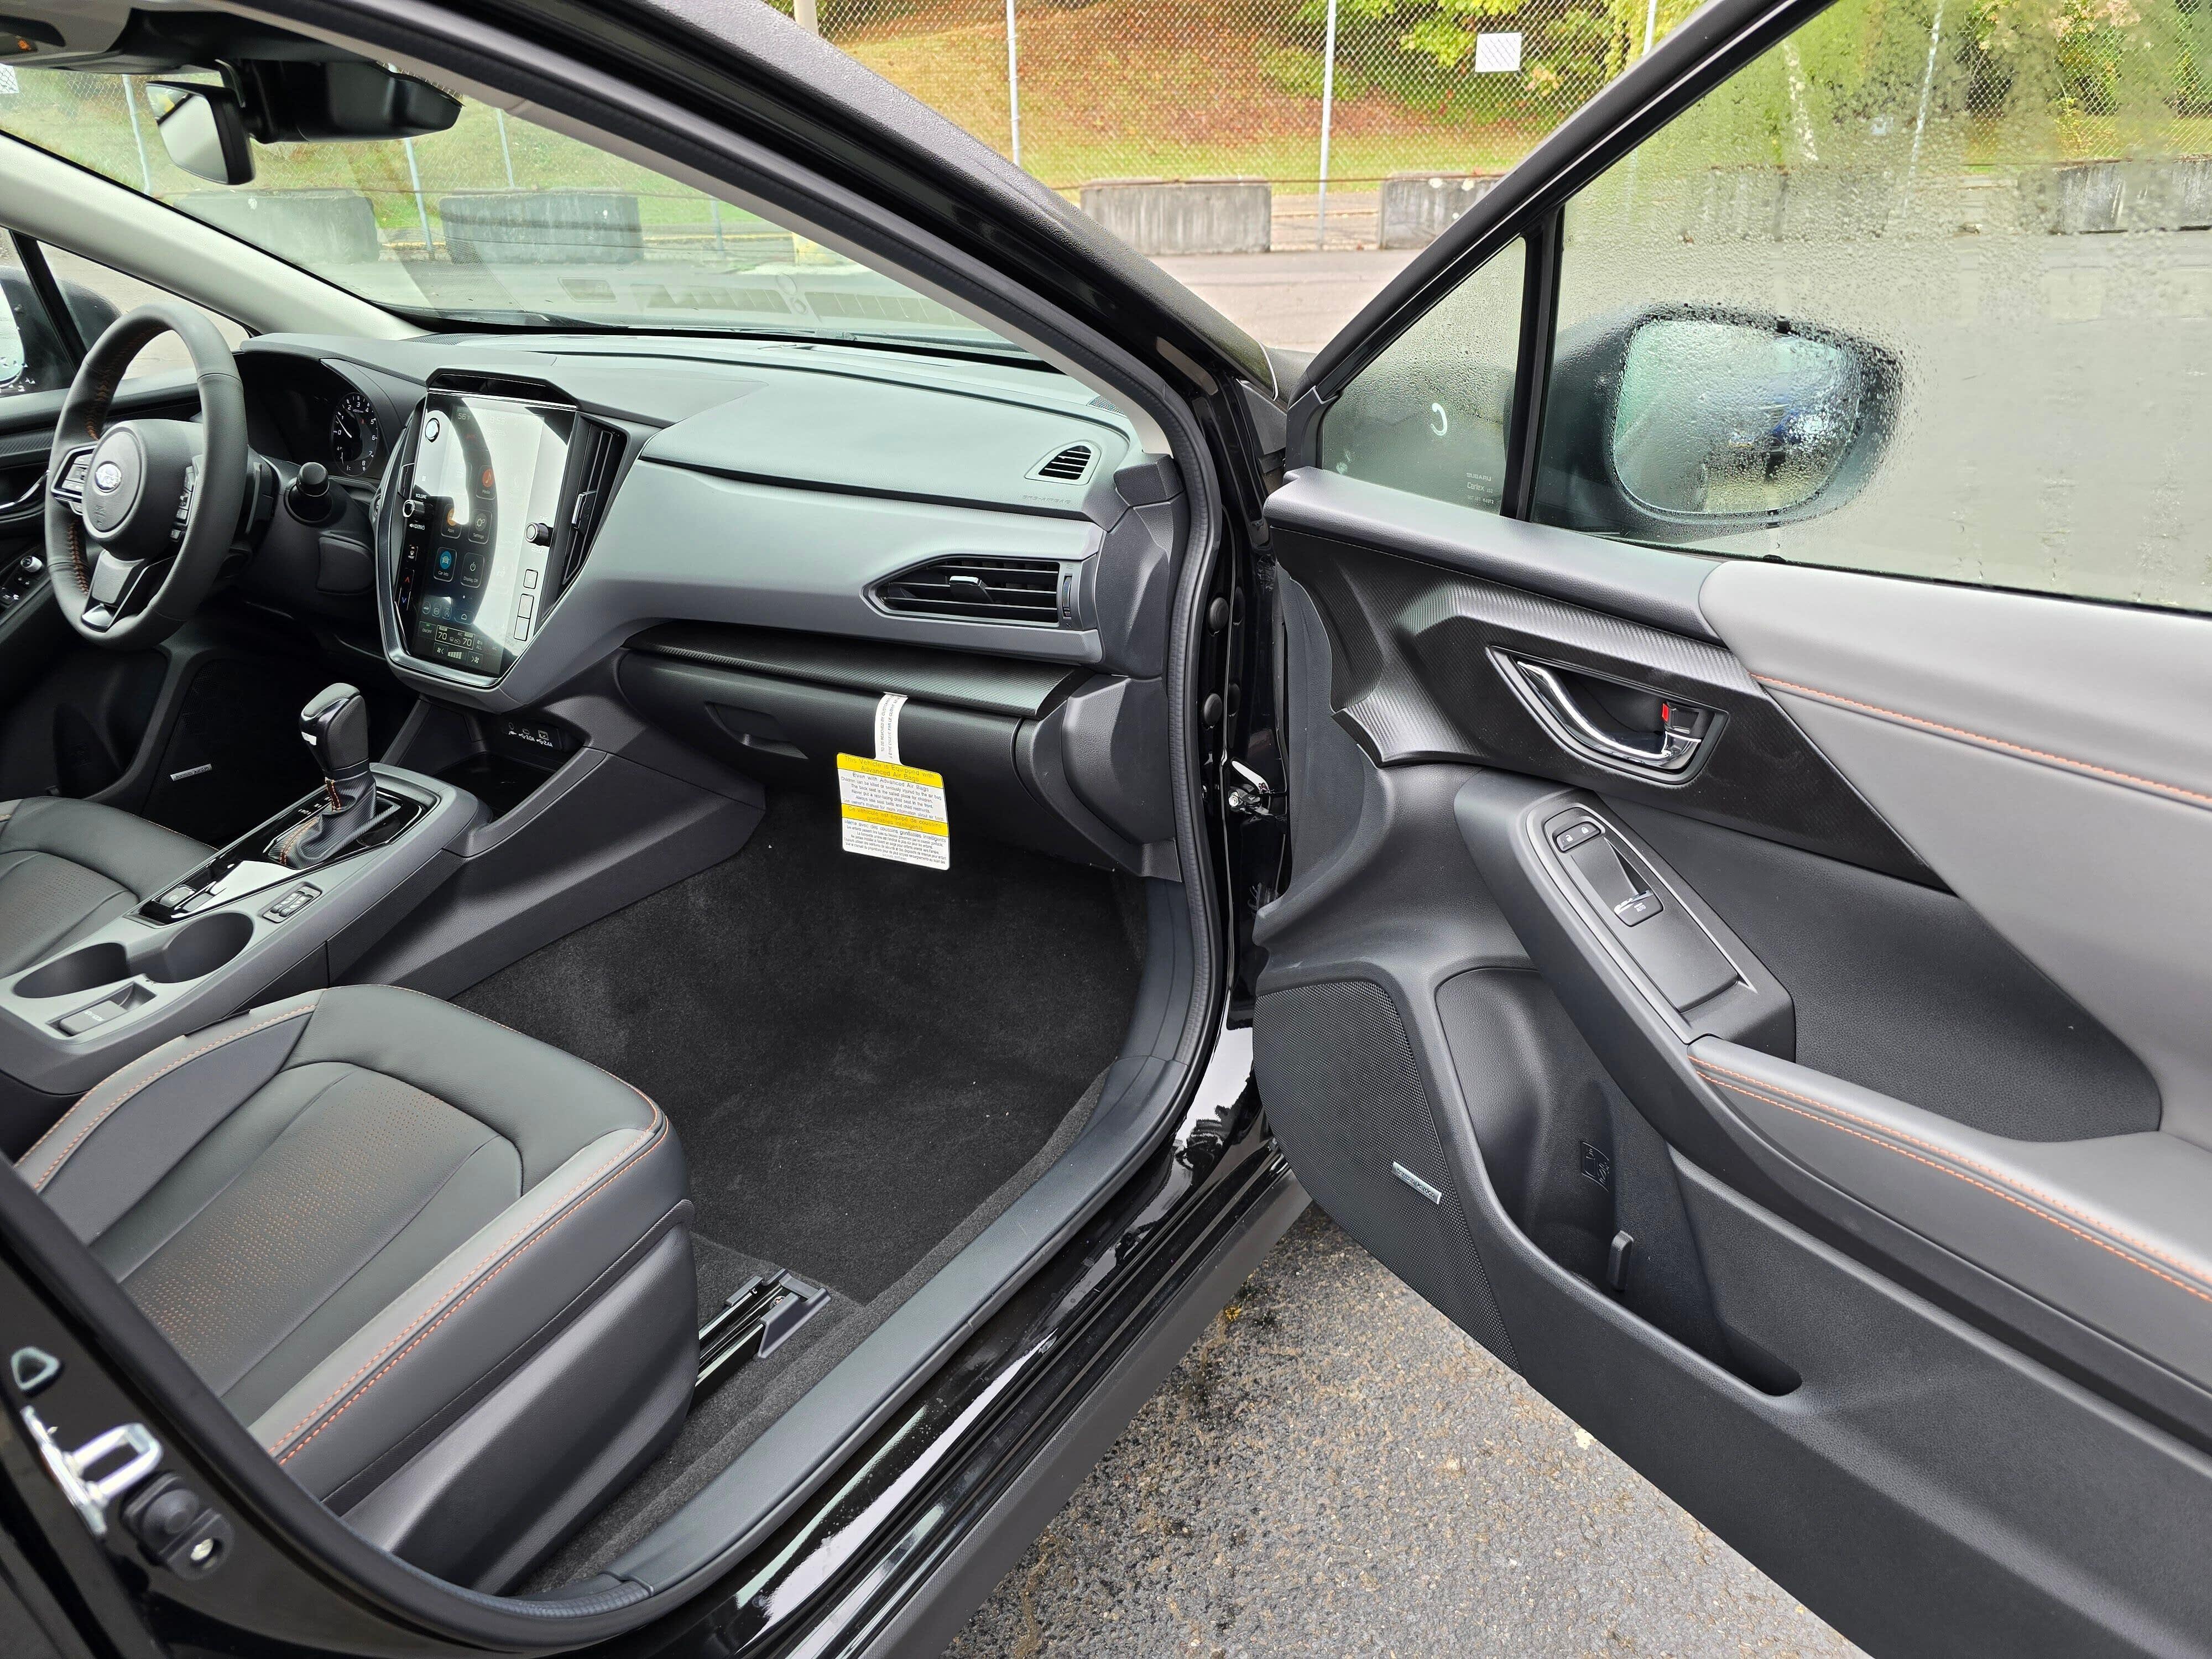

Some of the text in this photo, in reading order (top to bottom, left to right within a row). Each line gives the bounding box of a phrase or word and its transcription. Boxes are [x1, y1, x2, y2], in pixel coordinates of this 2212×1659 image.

[1466, 472, 1491, 482] SUBARU
[1022, 495, 1072, 504] SRS-AIRBAG
[438, 632, 472, 646] 70 70
[859, 758, 881, 768] Vehicle
[891, 765, 919, 776] Equipped
[860, 765, 890, 776] Advanced
[904, 774, 919, 782] Bags
[879, 778, 904, 786] Advanced
[867, 815, 923, 831] gonflables intelligents
[919, 820, 942, 828] coussins
[900, 830, 921, 839] gonflables
[923, 834, 946, 843] intelligents
[1636, 904, 1646, 912] AUTO
